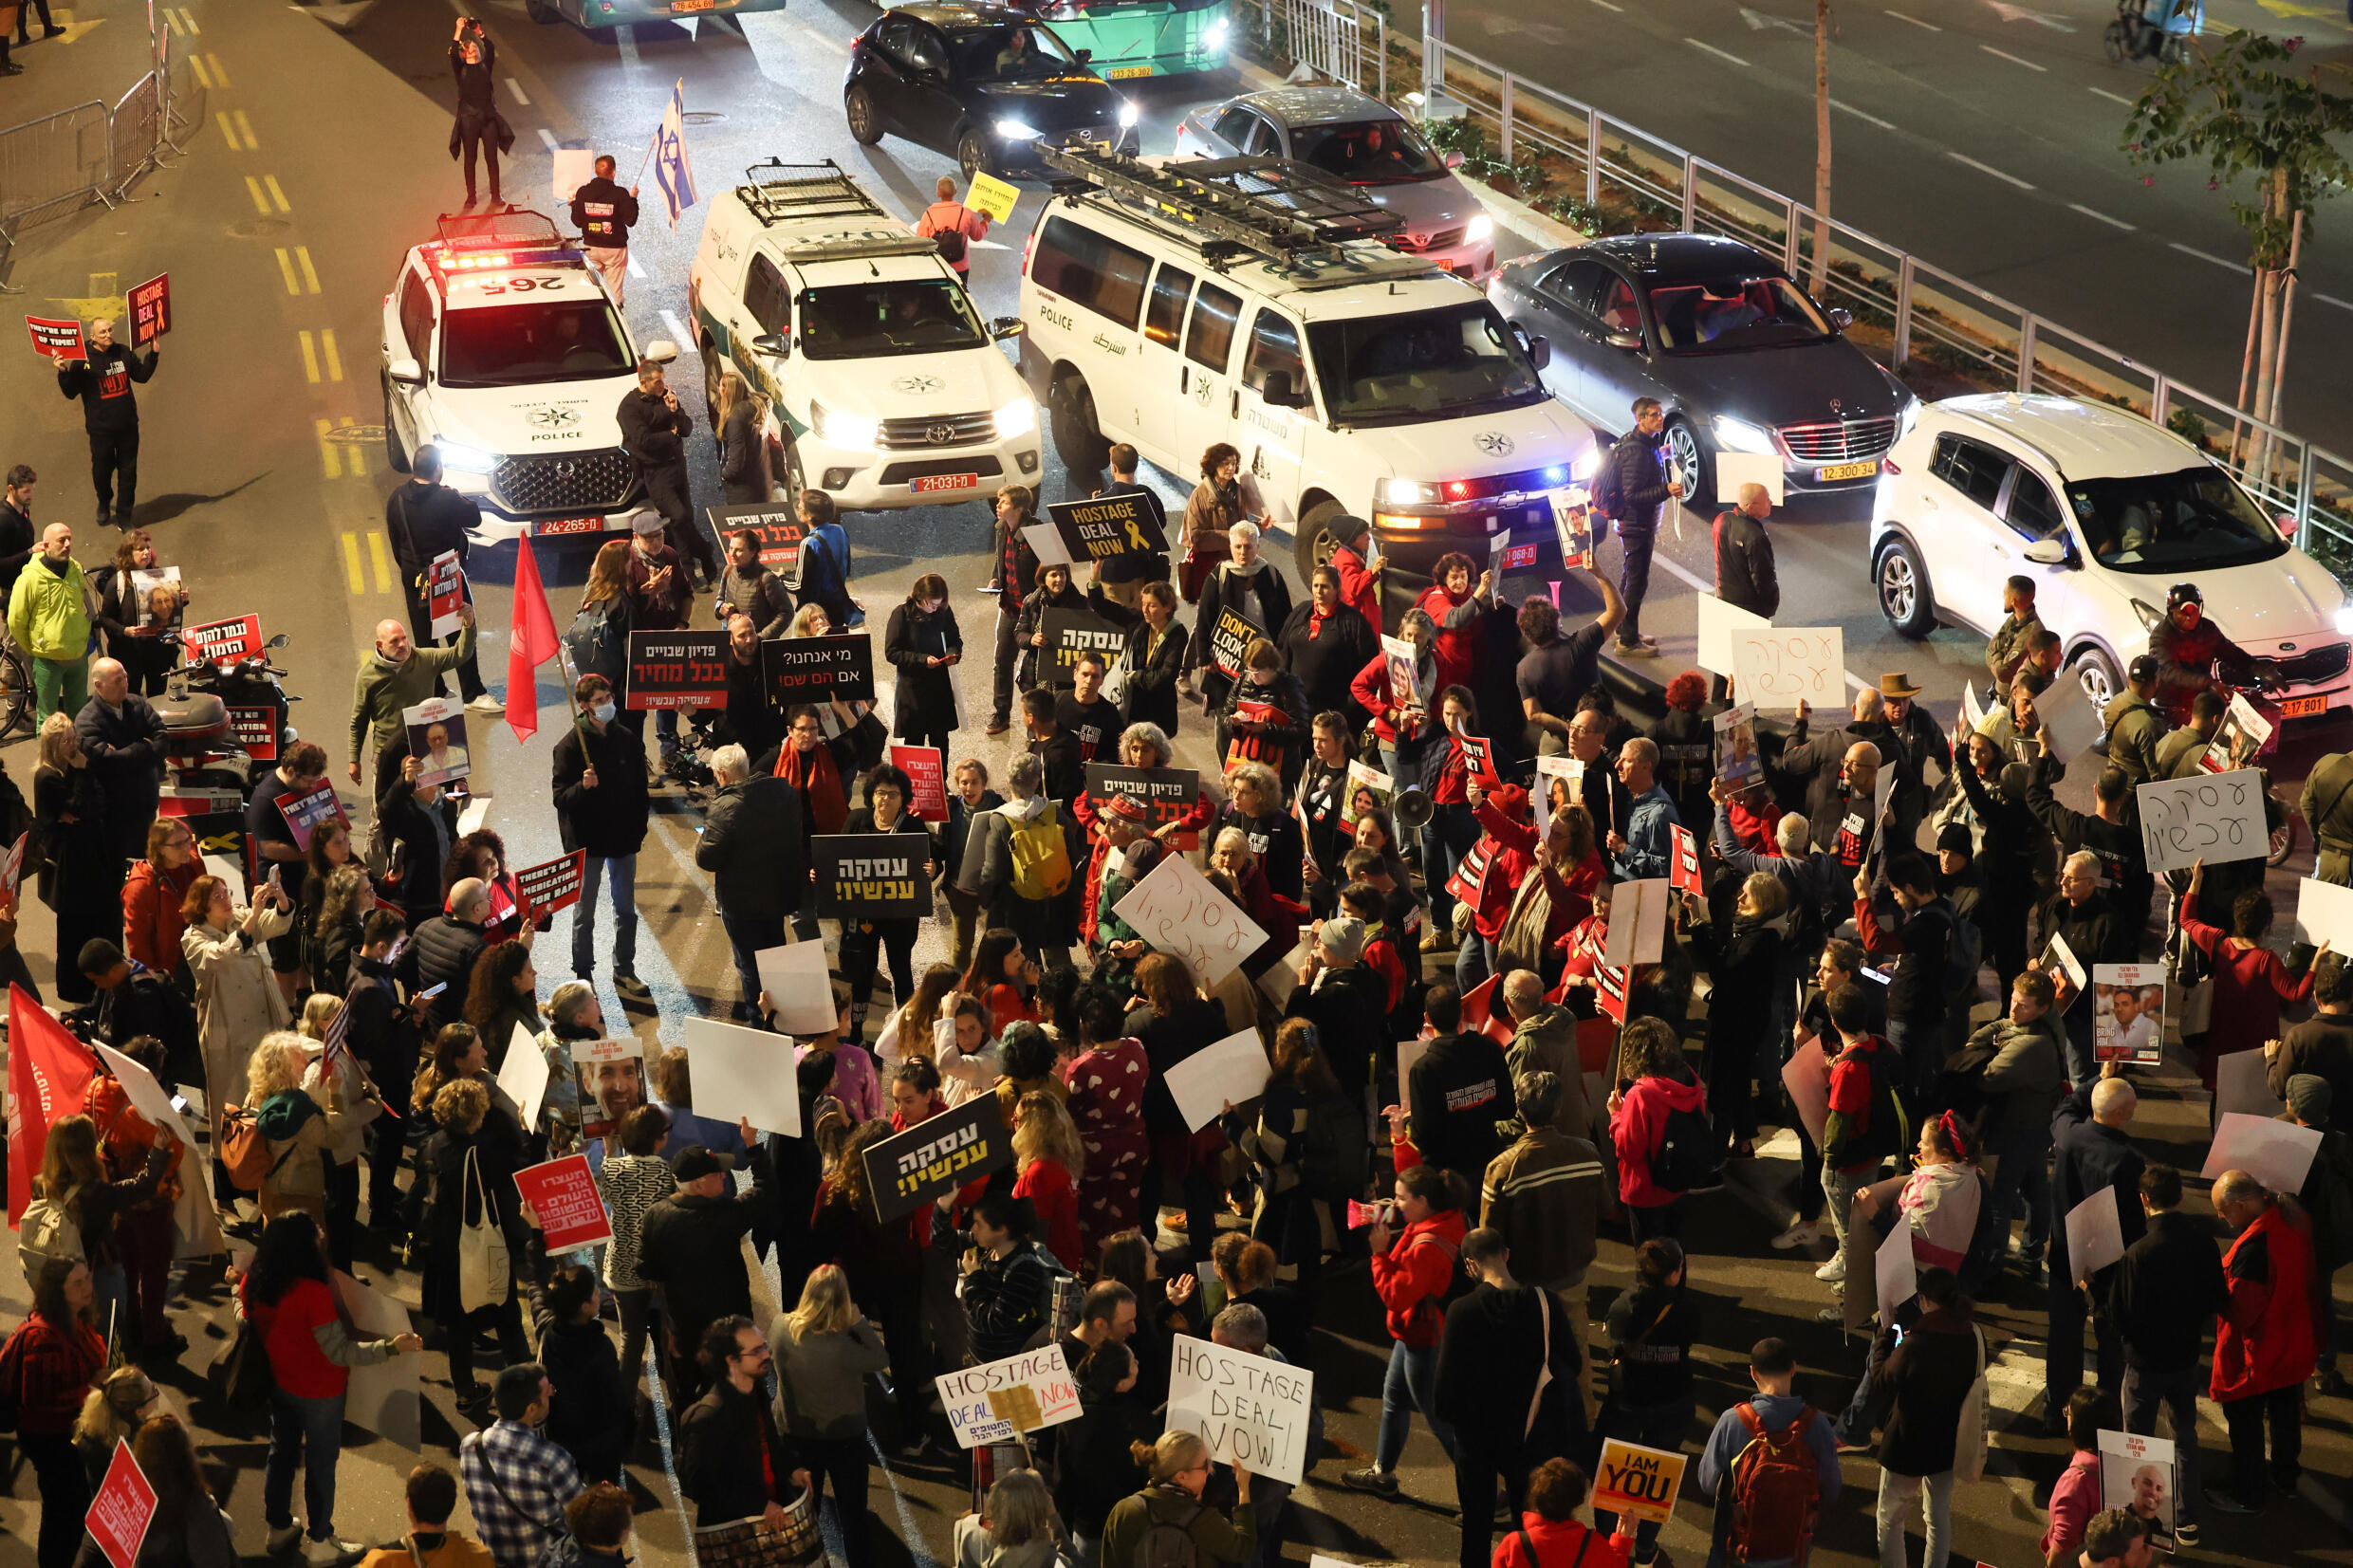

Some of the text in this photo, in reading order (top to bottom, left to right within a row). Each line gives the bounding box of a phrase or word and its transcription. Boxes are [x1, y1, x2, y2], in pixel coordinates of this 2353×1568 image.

[137, 281, 163, 307] HOSTAGE
[139, 304, 155, 323] DEAL
[1040, 305, 1073, 332] POLICE
[139, 320, 155, 342] NOW
[531, 432, 584, 442] POLICE
[727, 512, 787, 526] פדיון שבויים
[1071, 502, 1137, 524] HOSTAGE
[769, 526, 803, 542] בכל
[1078, 520, 1118, 539] DEAL
[1085, 538, 1125, 556] NOW
[222, 622, 247, 638] נגמר
[1220, 613, 1256, 643] DON'T
[203, 639, 243, 658] הזמן!
[1063, 629, 1124, 651] עסקה
[1213, 628, 1247, 658] LOOK
[646, 645, 715, 658] פדיון שבויים
[784, 649, 852, 666] מי אנחנו?
[634, 662, 725, 683] בכל מחיר
[779, 670, 860, 687] אם הם שם!
[645, 694, 674, 706] עכשיו!
[1104, 780, 1182, 796] פדיון שבויים
[283, 795, 316, 816] THEY'RE
[1154, 798, 1194, 821] בכל
[2149, 784, 2247, 821] עסקה
[519, 858, 571, 884] THERE'S NO
[838, 858, 908, 881] עסקה
[523, 869, 578, 896] MEDICATION
[554, 880, 580, 899] RAPE
[835, 880, 915, 900] עכשיו!
[2097, 1027, 2115, 1037] BRING
[898, 1122, 977, 1174] עסקה
[897, 1139, 989, 1197] עכשיו!
[542, 1169, 586, 1188] תעצרו
[567, 1178, 589, 1191] את
[547, 1188, 593, 1207] העולם
[945, 1351, 1063, 1398] HOSTAGE
[1178, 1345, 1305, 1404] HOSTAGE
[950, 1382, 1076, 1429] DEAL NOW
[1212, 1389, 1283, 1430] DEAL
[970, 1419, 1011, 1434] החטופים
[994, 1428, 1012, 1437] לפני
[1201, 1419, 1292, 1470] NOW!
[1624, 1453, 1660, 1472] I AM
[1607, 1463, 1670, 1502] YOU
